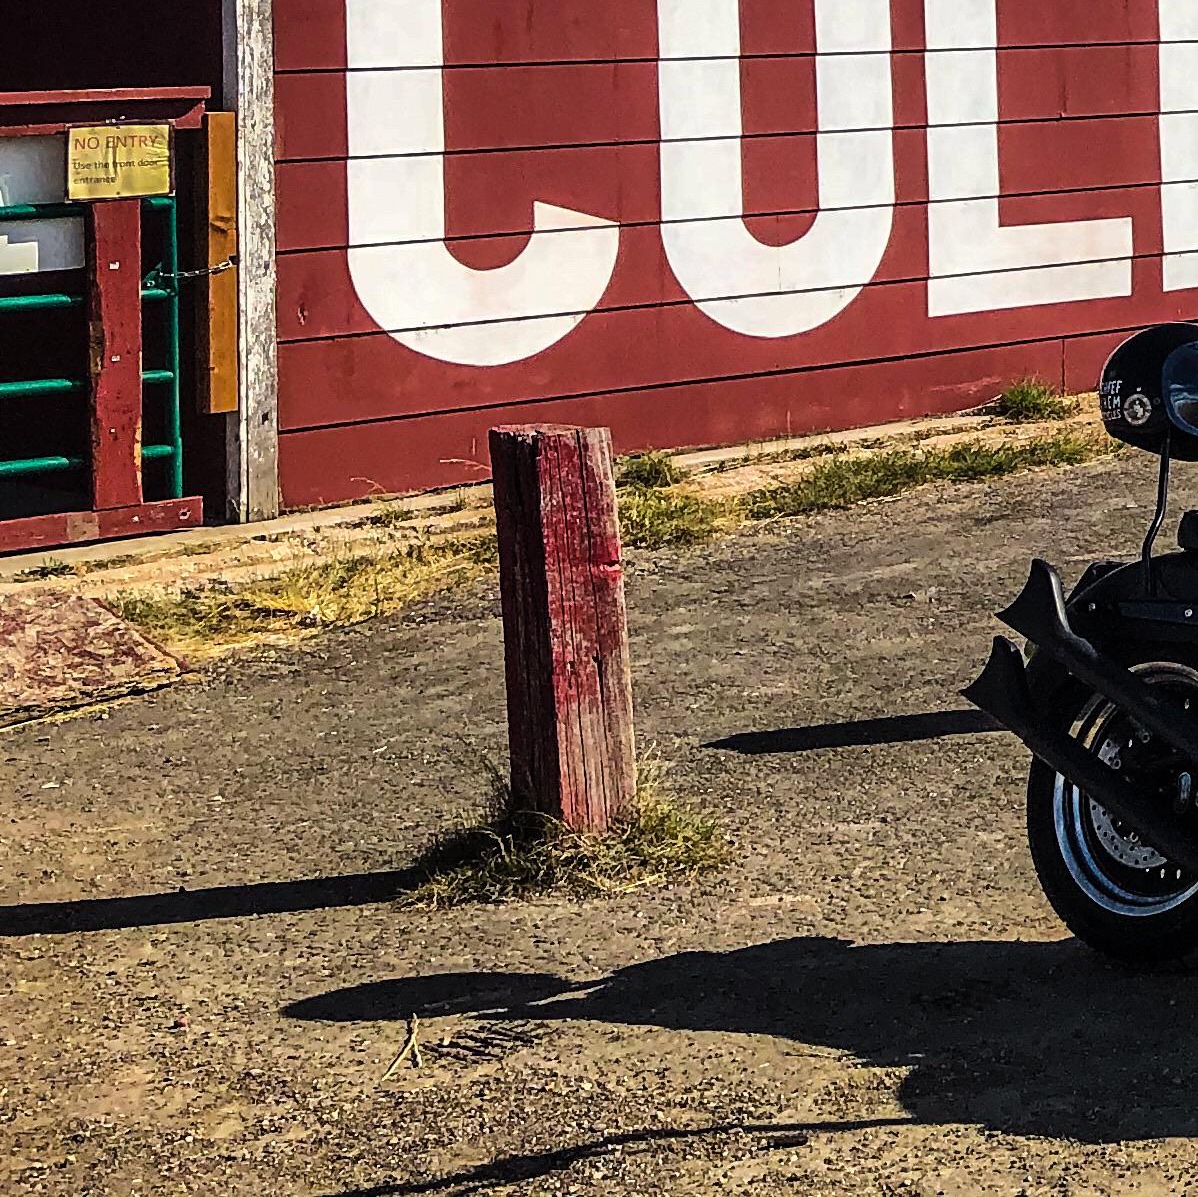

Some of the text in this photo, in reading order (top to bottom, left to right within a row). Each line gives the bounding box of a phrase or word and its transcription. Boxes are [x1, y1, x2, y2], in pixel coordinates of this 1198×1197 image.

[74, 134, 159, 151] NO ENTRY
[73, 161, 92, 170] Use
[73, 175, 117, 185] entrance
